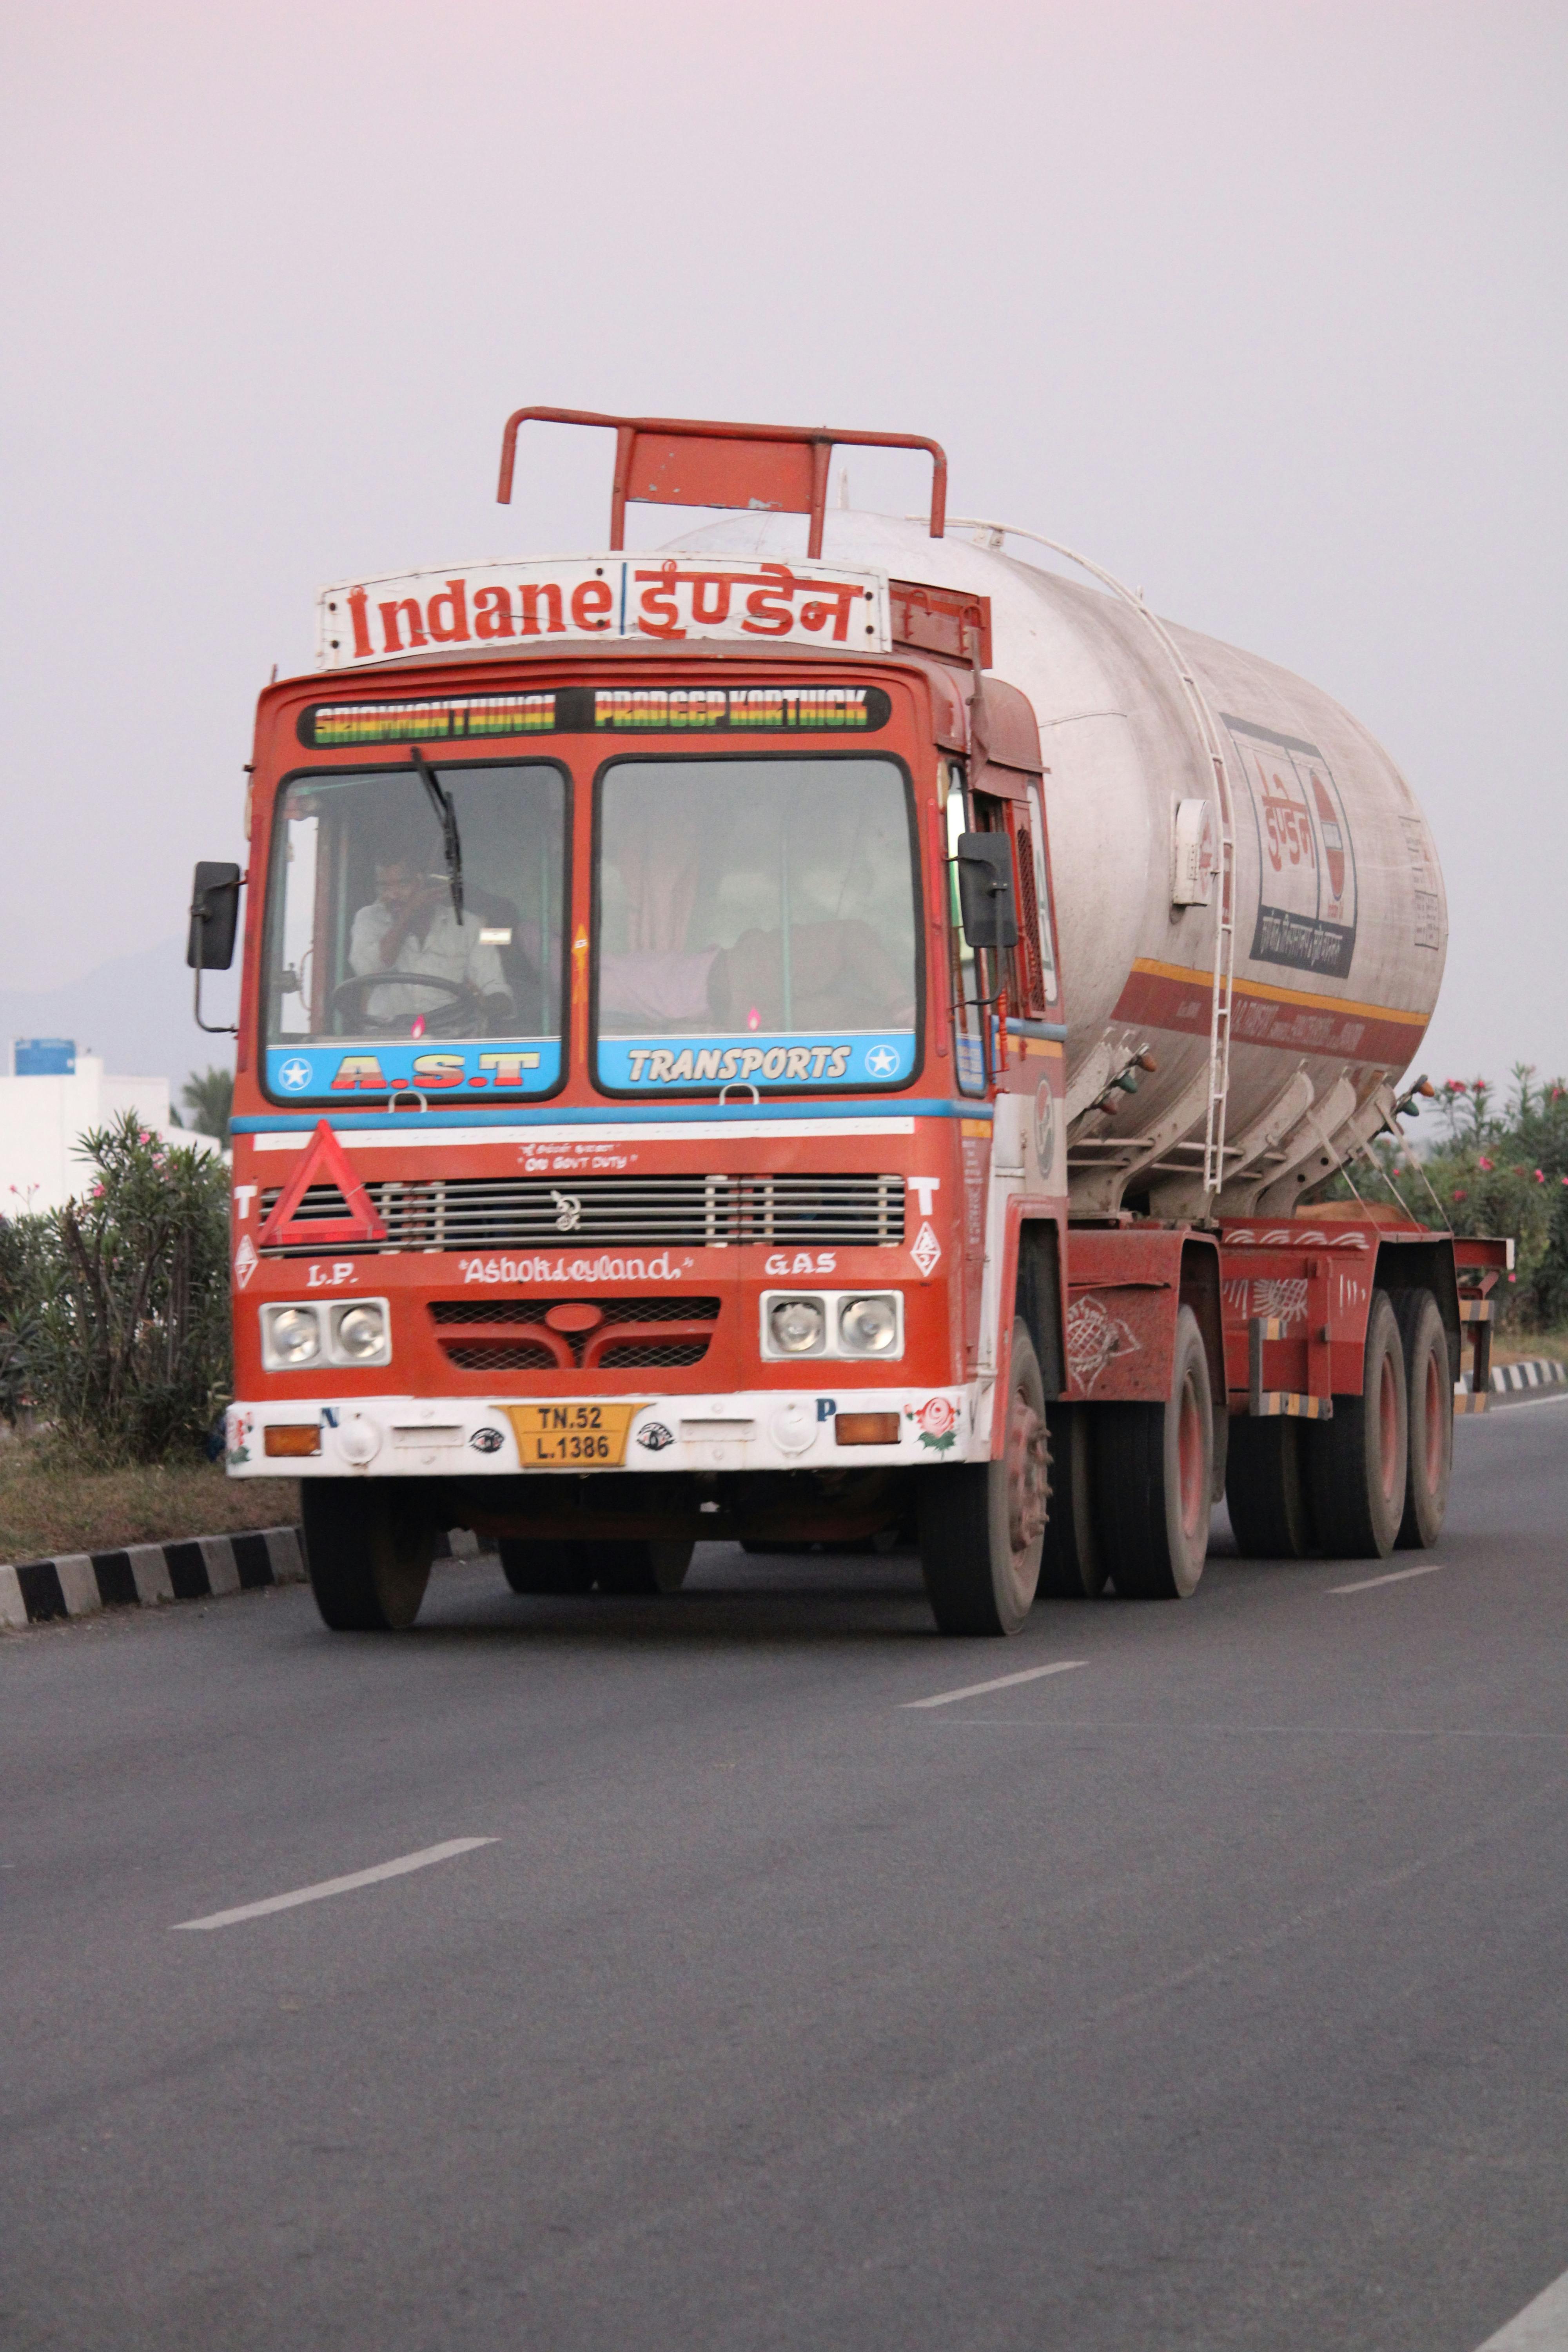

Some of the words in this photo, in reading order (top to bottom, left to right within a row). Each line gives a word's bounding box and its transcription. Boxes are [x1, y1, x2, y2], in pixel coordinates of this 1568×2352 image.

[346, 579, 613, 659] Indane
[595, 691, 726, 727] PRADEEP
[728, 690, 867, 726] KARTHICK
[330, 1052, 541, 1090] A.S.T
[628, 1045, 852, 1083] TRANSPORTS
[234, 1185, 258, 1220] T
[907, 1176, 940, 1216] T
[765, 1252, 837, 1276] GAS
[537, 1407, 602, 1429] TN.52
[815, 1398, 837, 1422] P
[537, 1435, 610, 1459] L.1386
